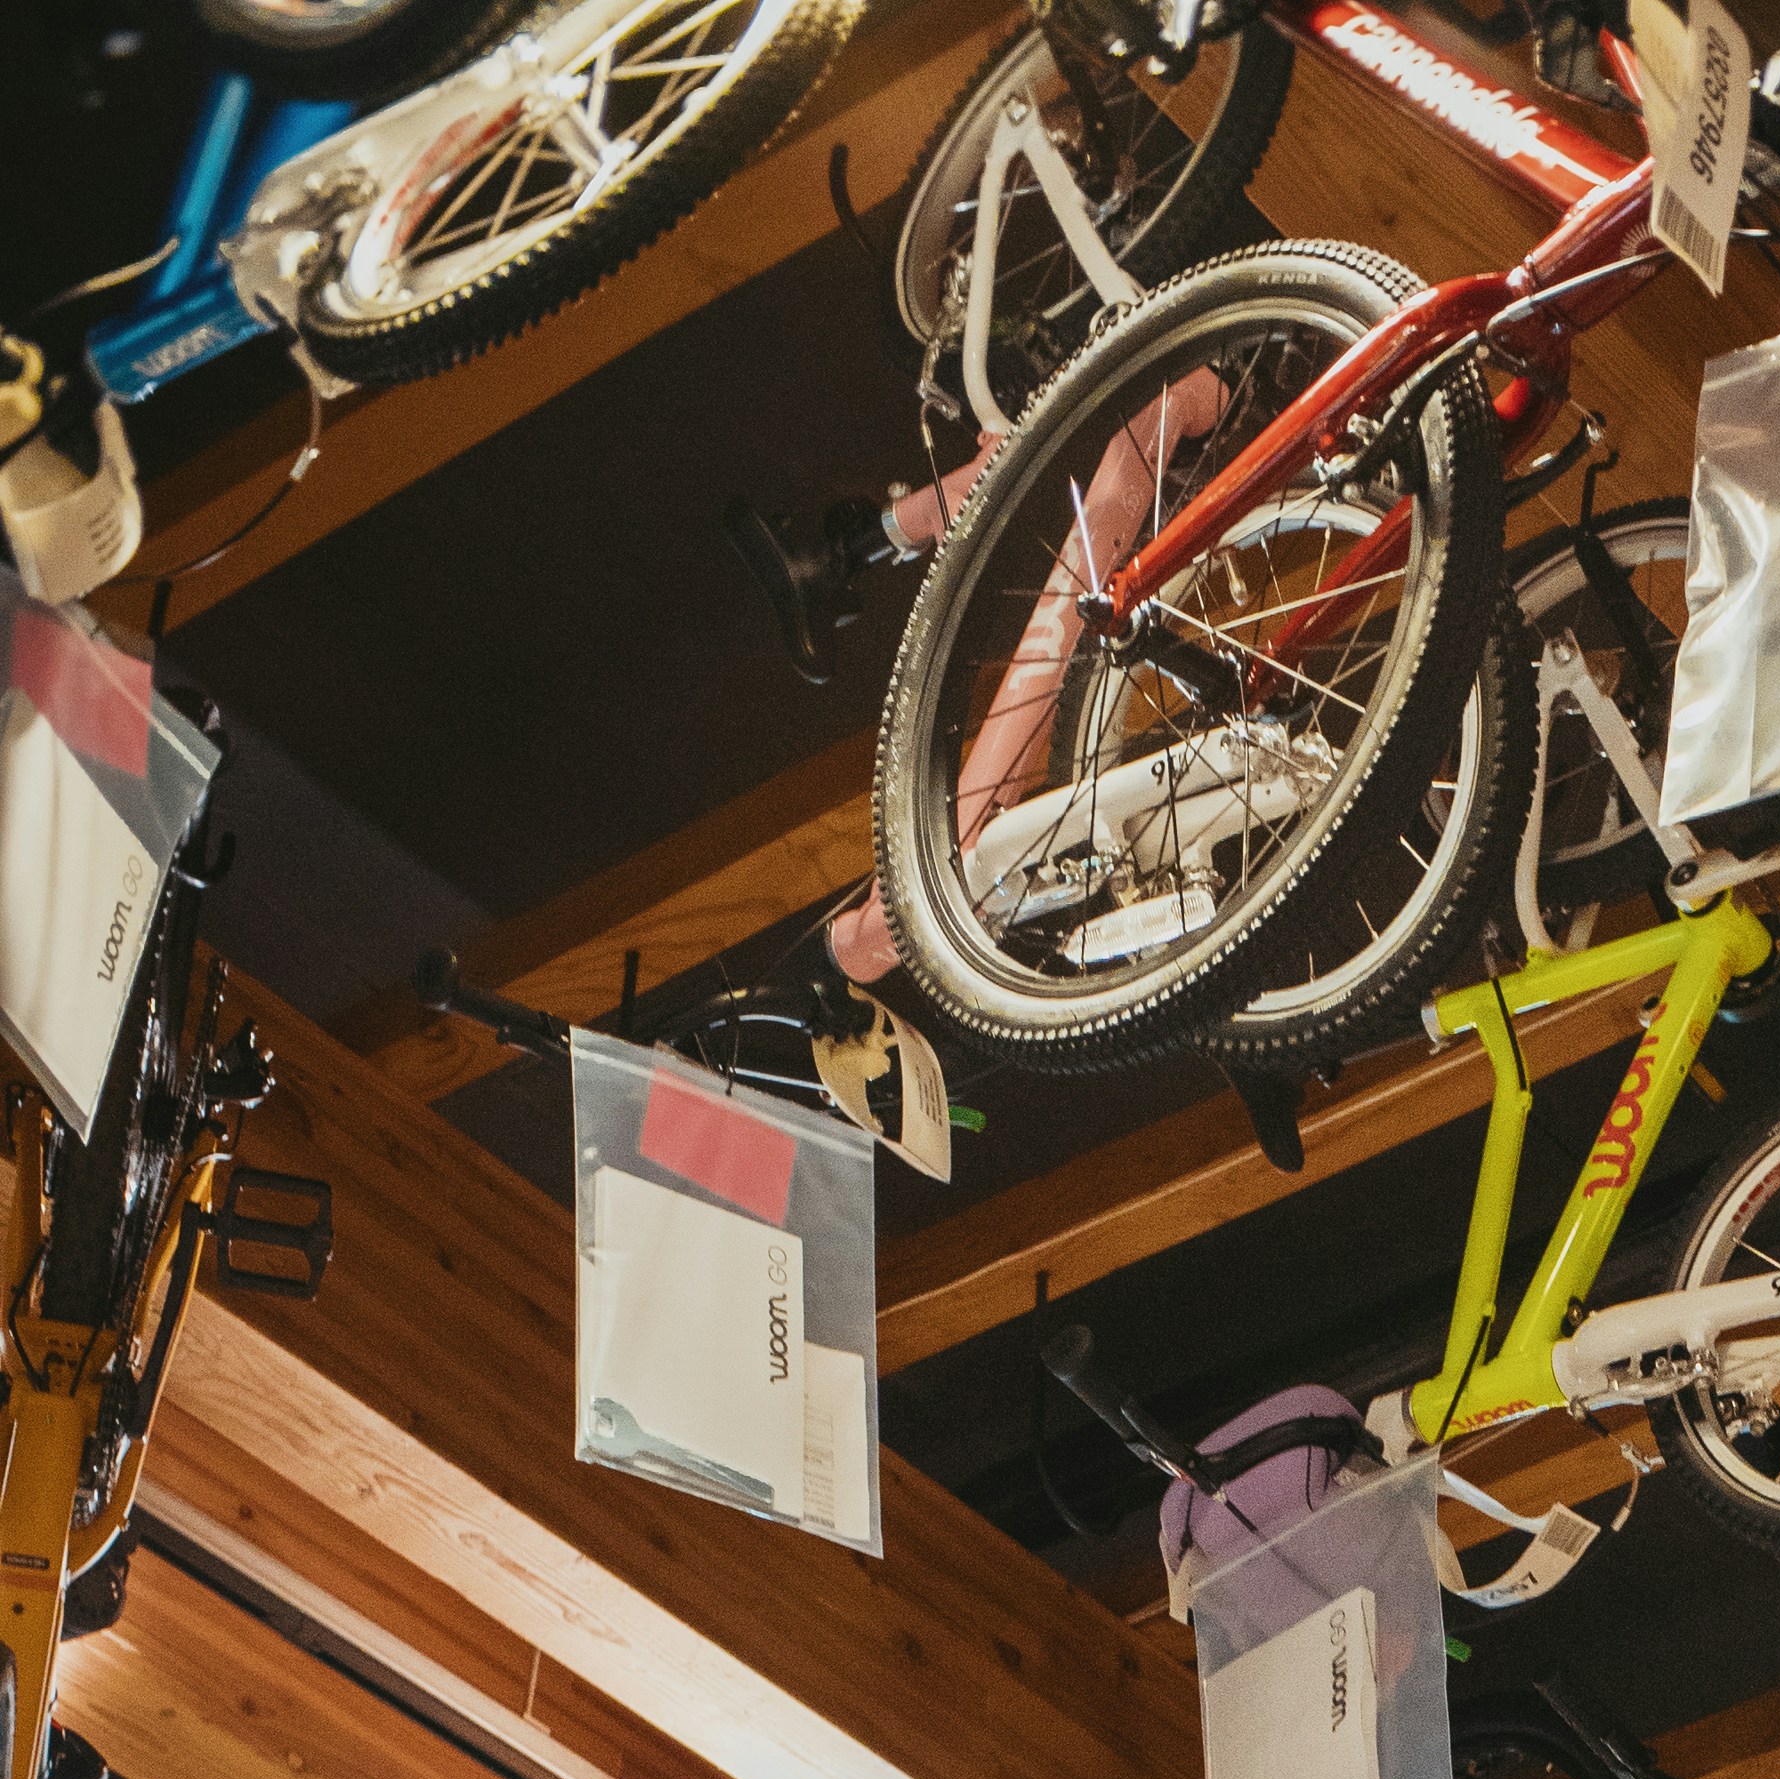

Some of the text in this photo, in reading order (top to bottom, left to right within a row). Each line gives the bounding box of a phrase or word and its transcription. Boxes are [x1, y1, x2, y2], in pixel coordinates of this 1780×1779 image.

[1689, 25, 1731, 185] 03257946
[1257, 272, 1319, 286] KENDA
[96, 854, 144, 983] woom GO
[767, 1244, 790, 1385] woom GO
[1328, 1608, 1348, 1733] woom GO
